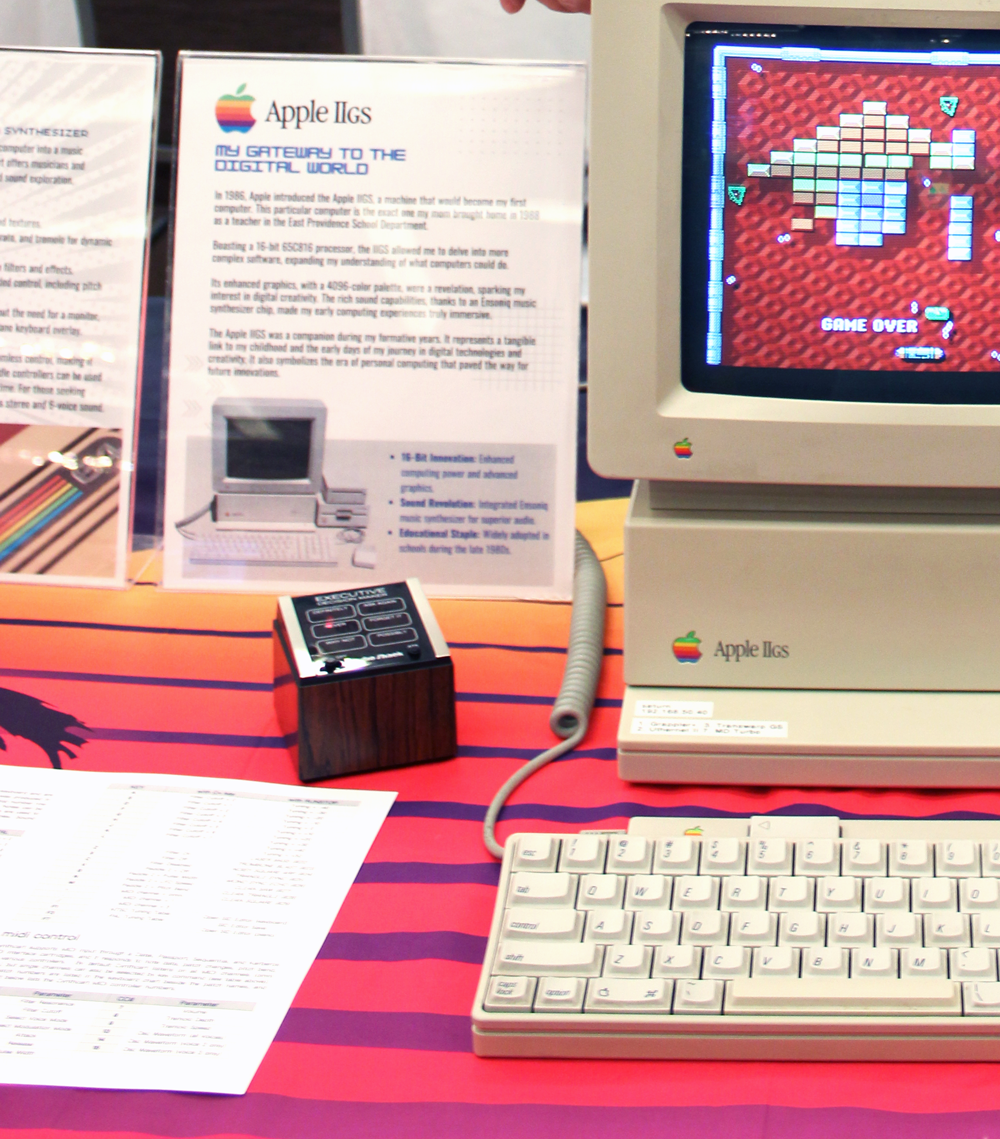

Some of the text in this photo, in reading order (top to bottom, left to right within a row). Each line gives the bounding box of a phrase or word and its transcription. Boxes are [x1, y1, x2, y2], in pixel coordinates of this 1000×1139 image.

[265, 99, 329, 130] Apple
[4, 127, 89, 138] SYNTHESIZER
[215, 145, 406, 161] MY GATEWAY TO THE
[214, 159, 369, 175] DIGITAL WORLD
[821, 318, 919, 334] GAME OVER
[315, 587, 387, 602] EXECUTIVE
[713, 639, 759, 662] Apple
[635, 887, 647, 897] W
[683, 888, 692, 897] E
[732, 888, 741, 897] R
[779, 888, 787, 897] T
[827, 888, 835, 897] Y
[875, 889, 885, 899] U
[595, 921, 604, 930] A
[643, 921, 653, 930] S
[692, 921, 702, 931] D
[742, 922, 750, 931] F
[789, 923, 799, 933] G
[839, 924, 849, 933] H
[887, 925, 897, 934] J
[937, 924, 946, 932] K
[984, 925, 991, 933] L
[33, 932, 80, 941] control
[614, 955, 623, 965] Z
[663, 956, 673, 965] X
[714, 956, 723, 965] C
[763, 957, 772, 966] V
[814, 957, 823, 966] B
[863, 957, 874, 966] N
[912, 958, 926, 967] M
